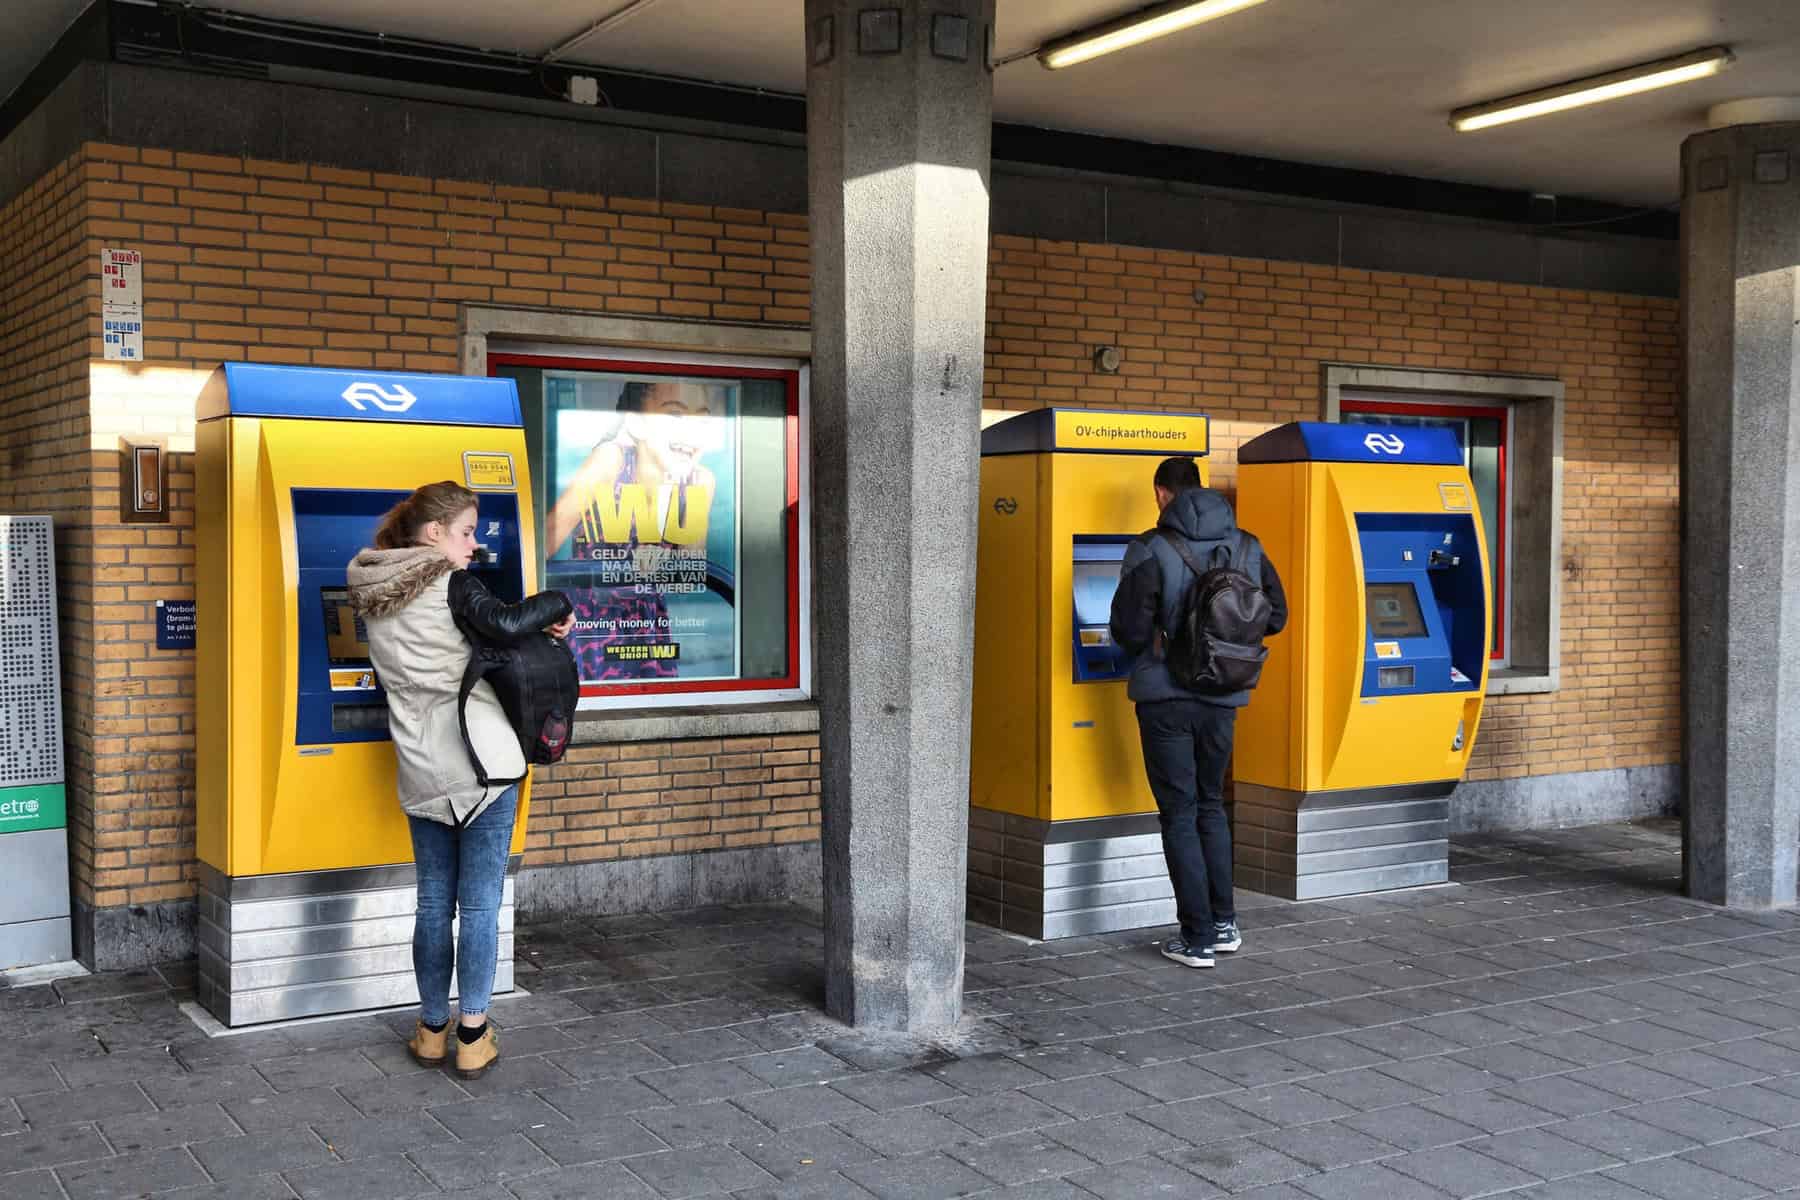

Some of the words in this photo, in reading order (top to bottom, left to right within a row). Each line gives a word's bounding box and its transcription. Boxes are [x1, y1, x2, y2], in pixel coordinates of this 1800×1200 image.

[1075, 425, 1187, 441] OV-chipkaarthouders
[592, 549, 628, 560] GELD
[631, 549, 707, 560] VERZENDEN
[646, 560, 707, 571] MAGHREB
[602, 572, 620, 583] EN
[624, 572, 641, 583] DE
[645, 571, 677, 582] REST
[680, 571, 707, 582] VAN
[635, 584, 653, 594] DE
[655, 583, 707, 594] WERELD
[575, 618, 617, 631] moving
[619, 618, 656, 630] money
[658, 617, 672, 628] for
[675, 616, 705, 628] better
[607, 646, 648, 654] WESTERN
[0, 799, 39, 815] etro
